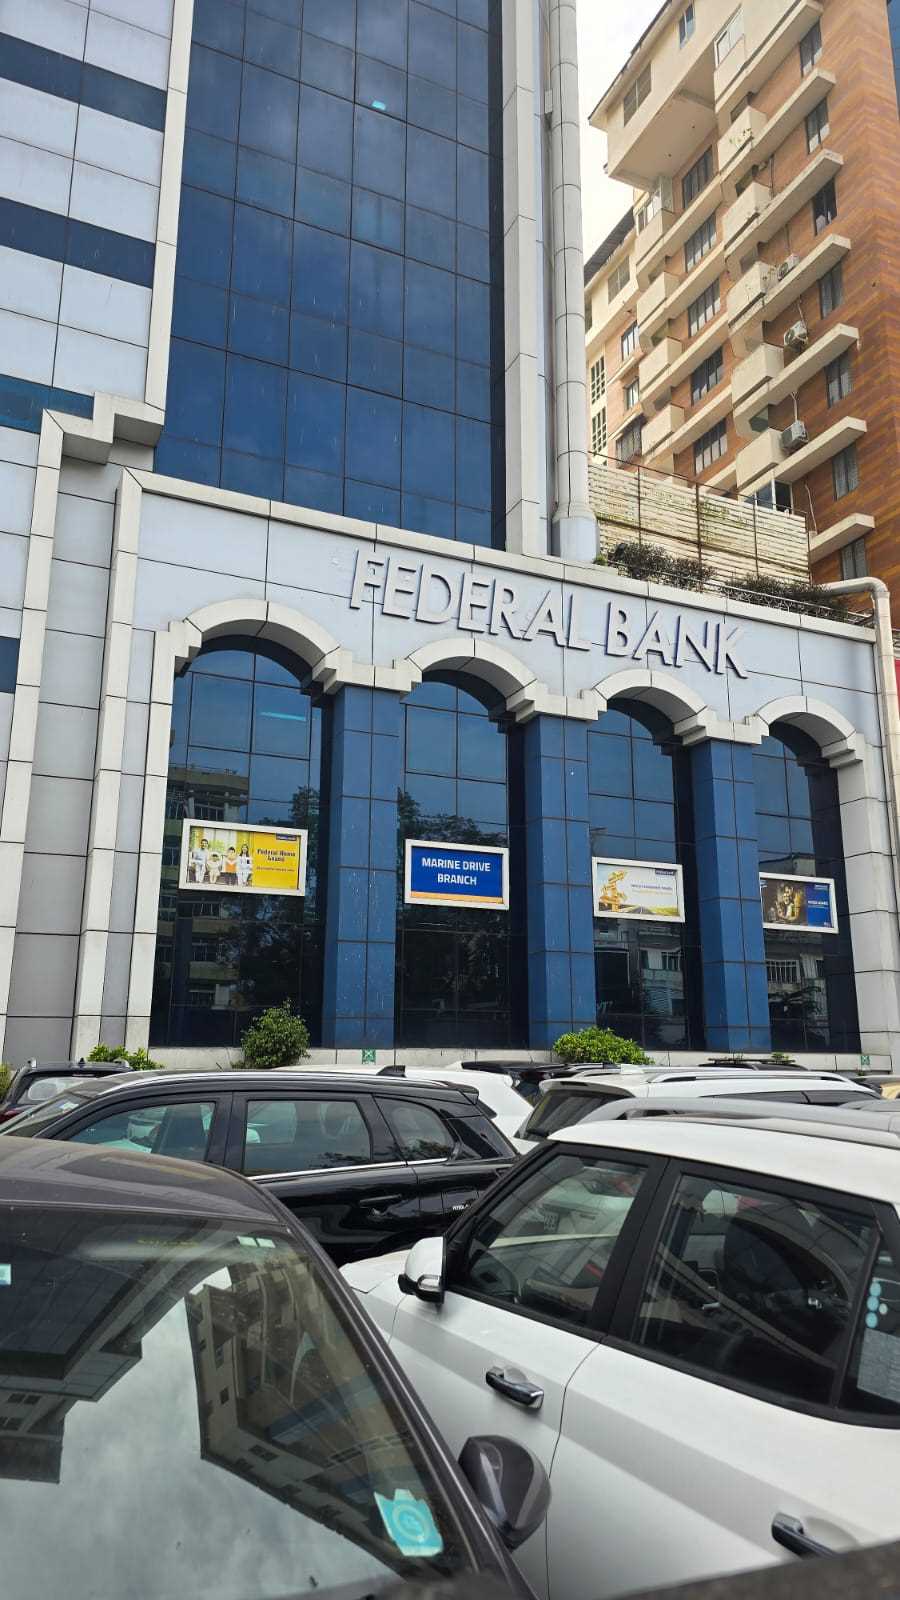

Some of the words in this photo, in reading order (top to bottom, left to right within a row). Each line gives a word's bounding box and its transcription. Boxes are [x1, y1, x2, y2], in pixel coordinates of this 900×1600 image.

[350, 547, 591, 652] FEDERAL
[604, 601, 748, 680] BANK
[421, 857, 461, 870] MARINE
[462, 860, 491, 872] DRIVE
[437, 872, 477, 886] BRANCH
